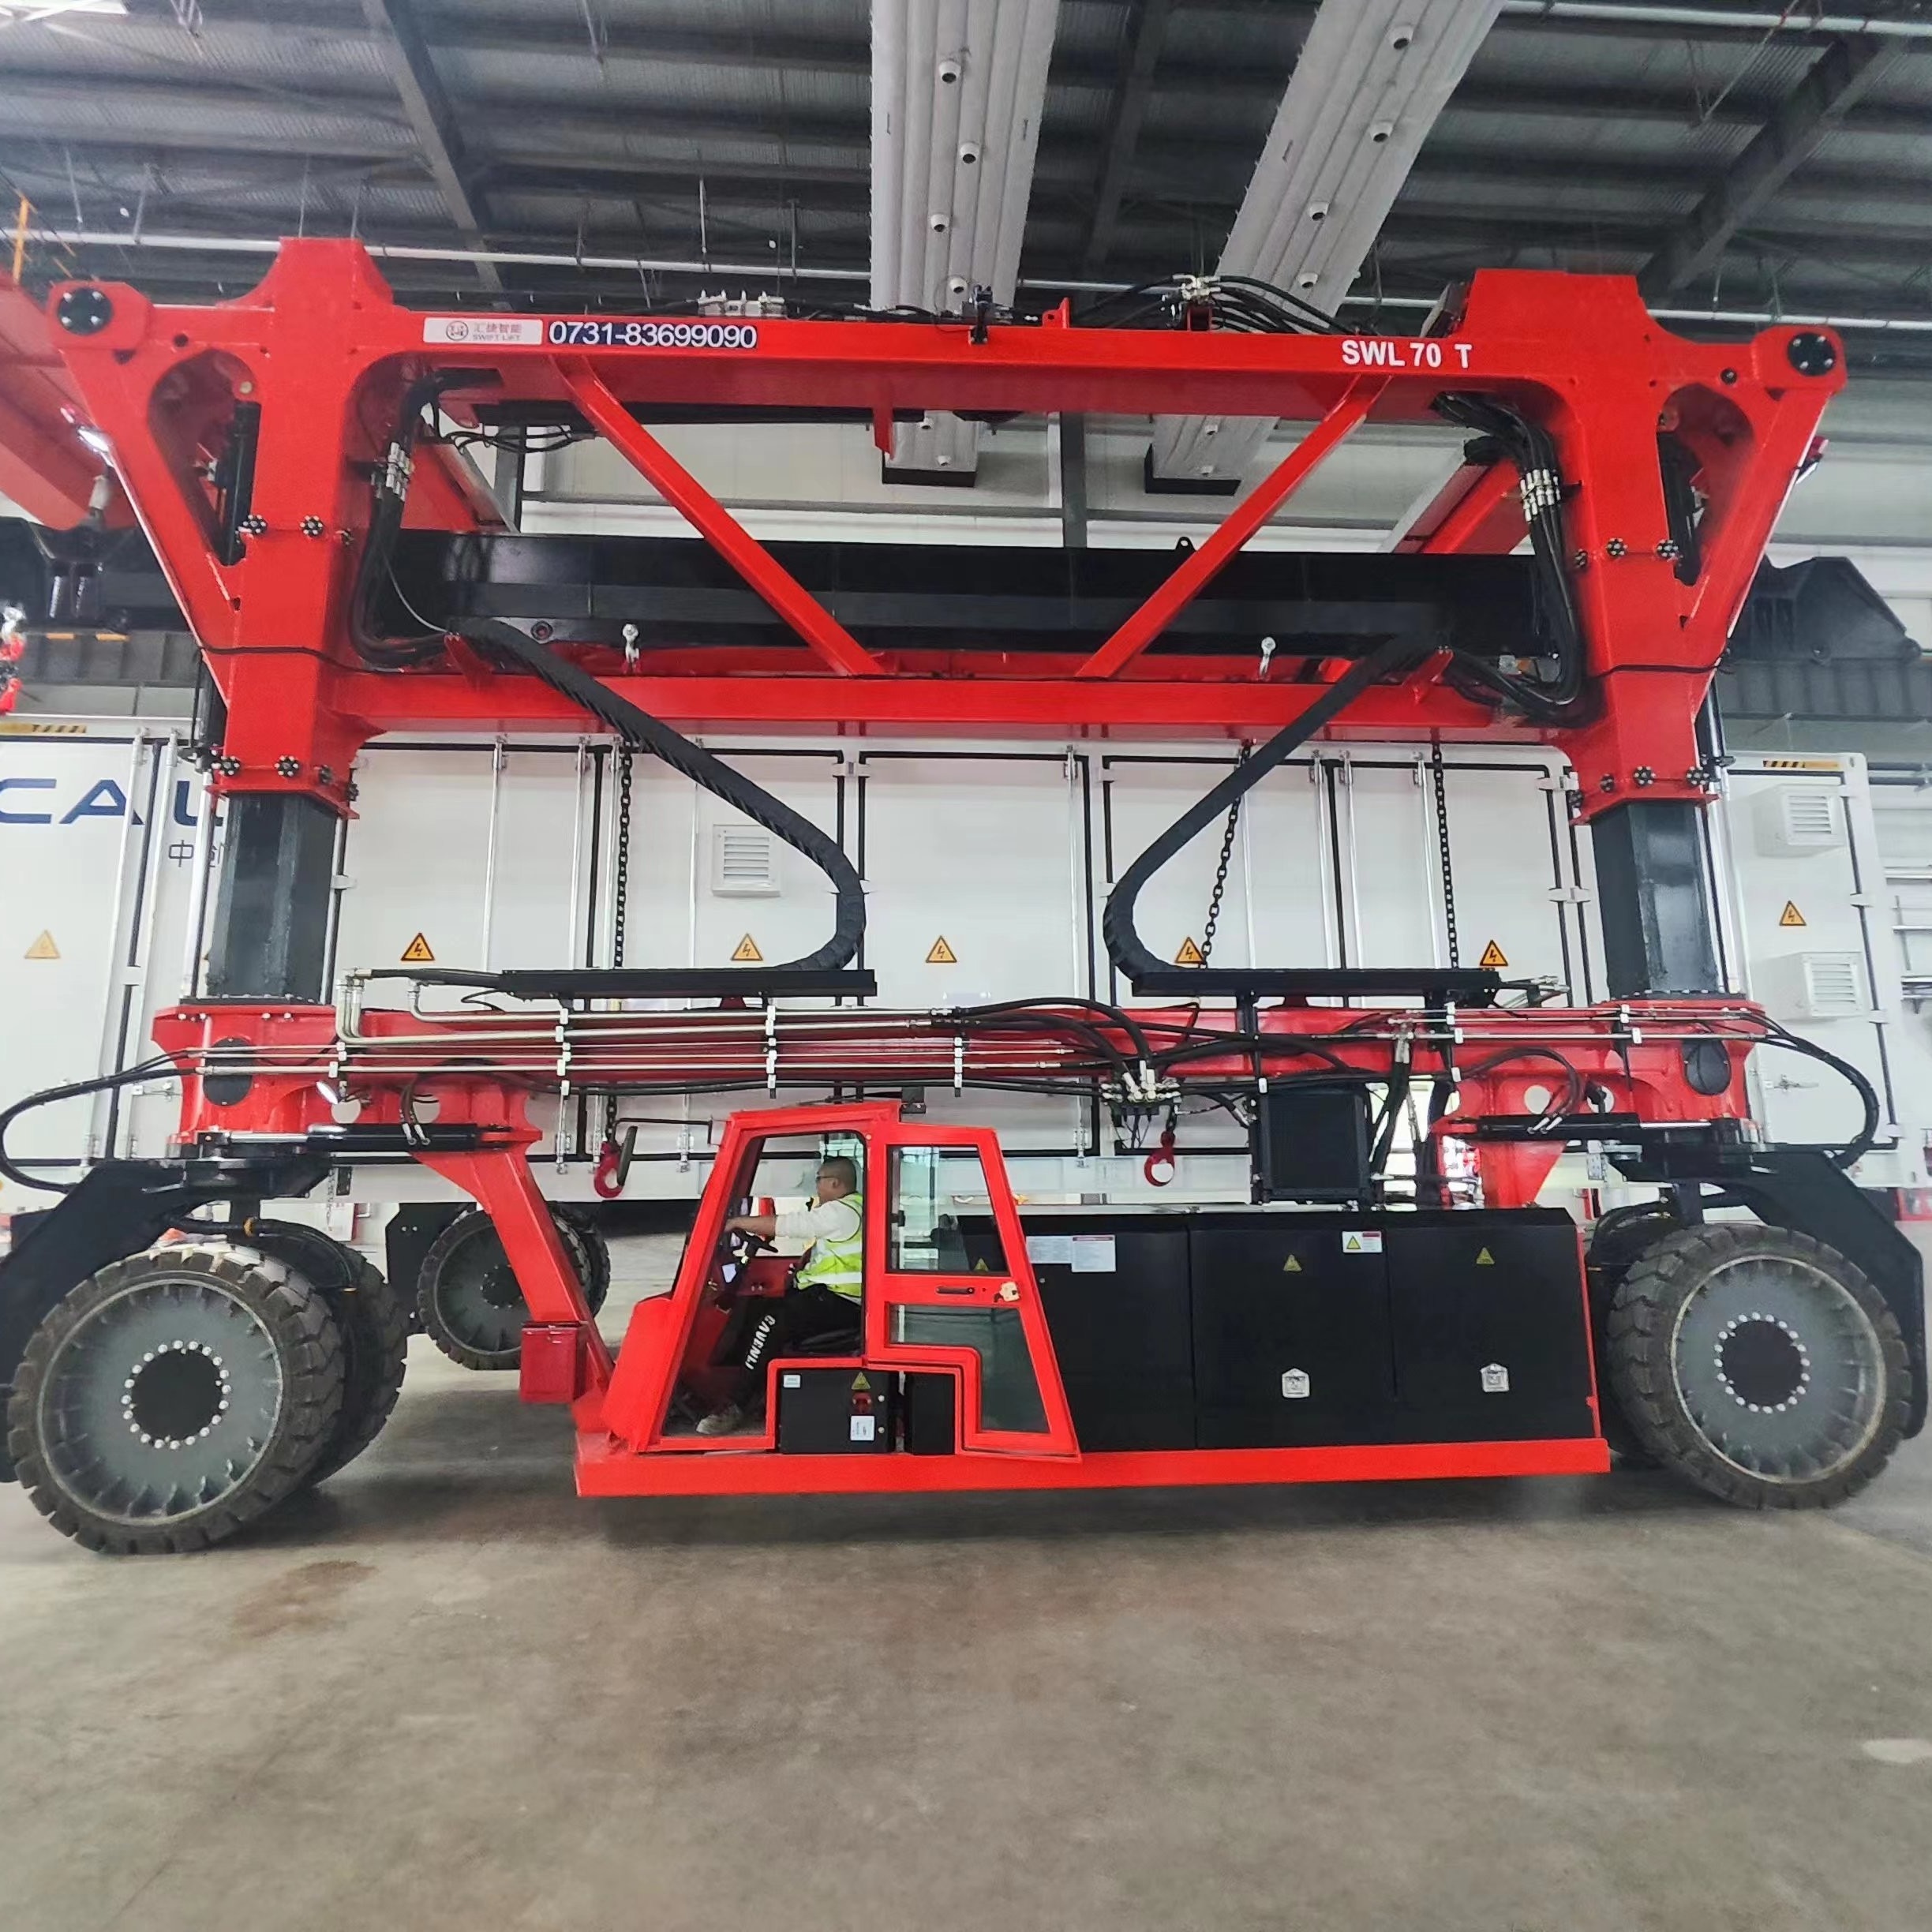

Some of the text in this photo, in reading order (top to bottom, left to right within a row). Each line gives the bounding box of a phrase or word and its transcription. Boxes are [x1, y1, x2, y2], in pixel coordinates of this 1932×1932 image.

[549, 321, 758, 348] 0731-83699090
[1342, 339, 1473, 369] SWL 70 T
